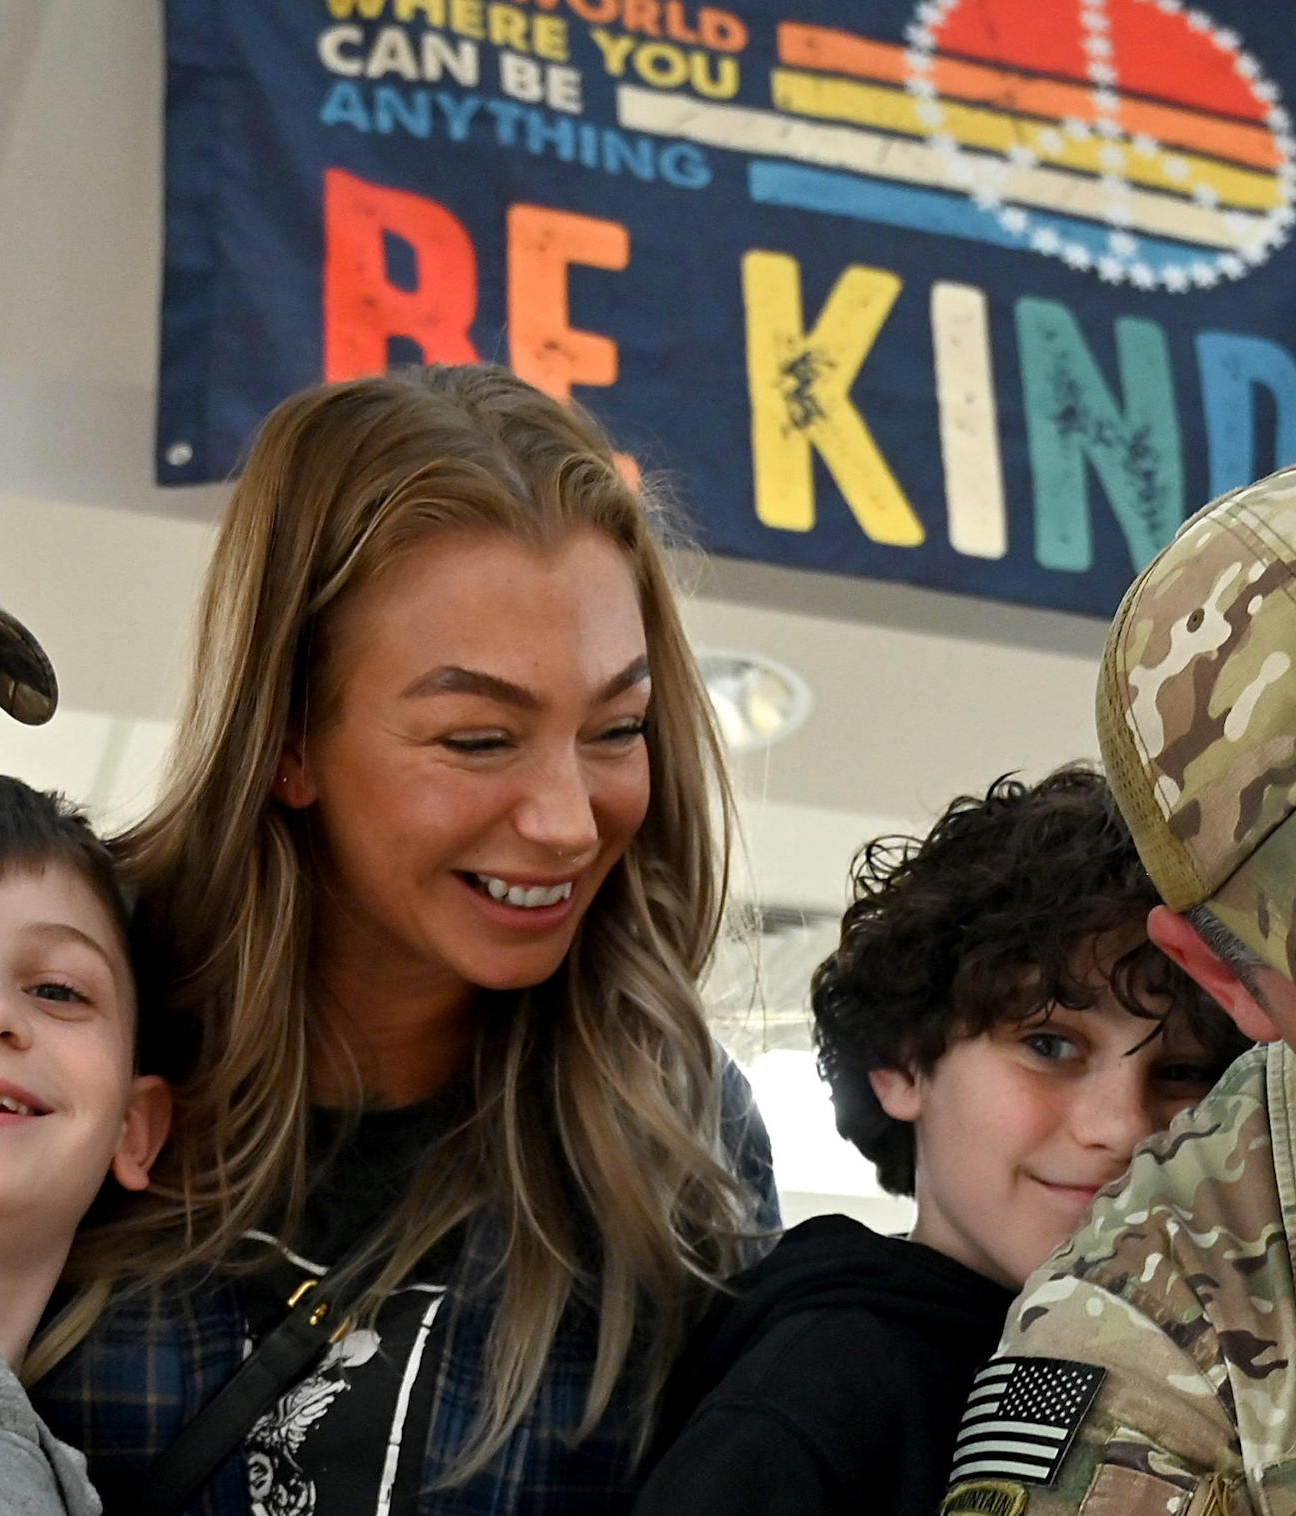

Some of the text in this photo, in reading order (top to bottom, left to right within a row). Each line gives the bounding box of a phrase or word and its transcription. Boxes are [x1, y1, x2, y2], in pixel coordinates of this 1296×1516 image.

[517, 0, 747, 53] ORLD
[591, 28, 739, 99] YOU
[317, 23, 583, 115] CAN BE
[319, 80, 713, 189] ANYTHING
